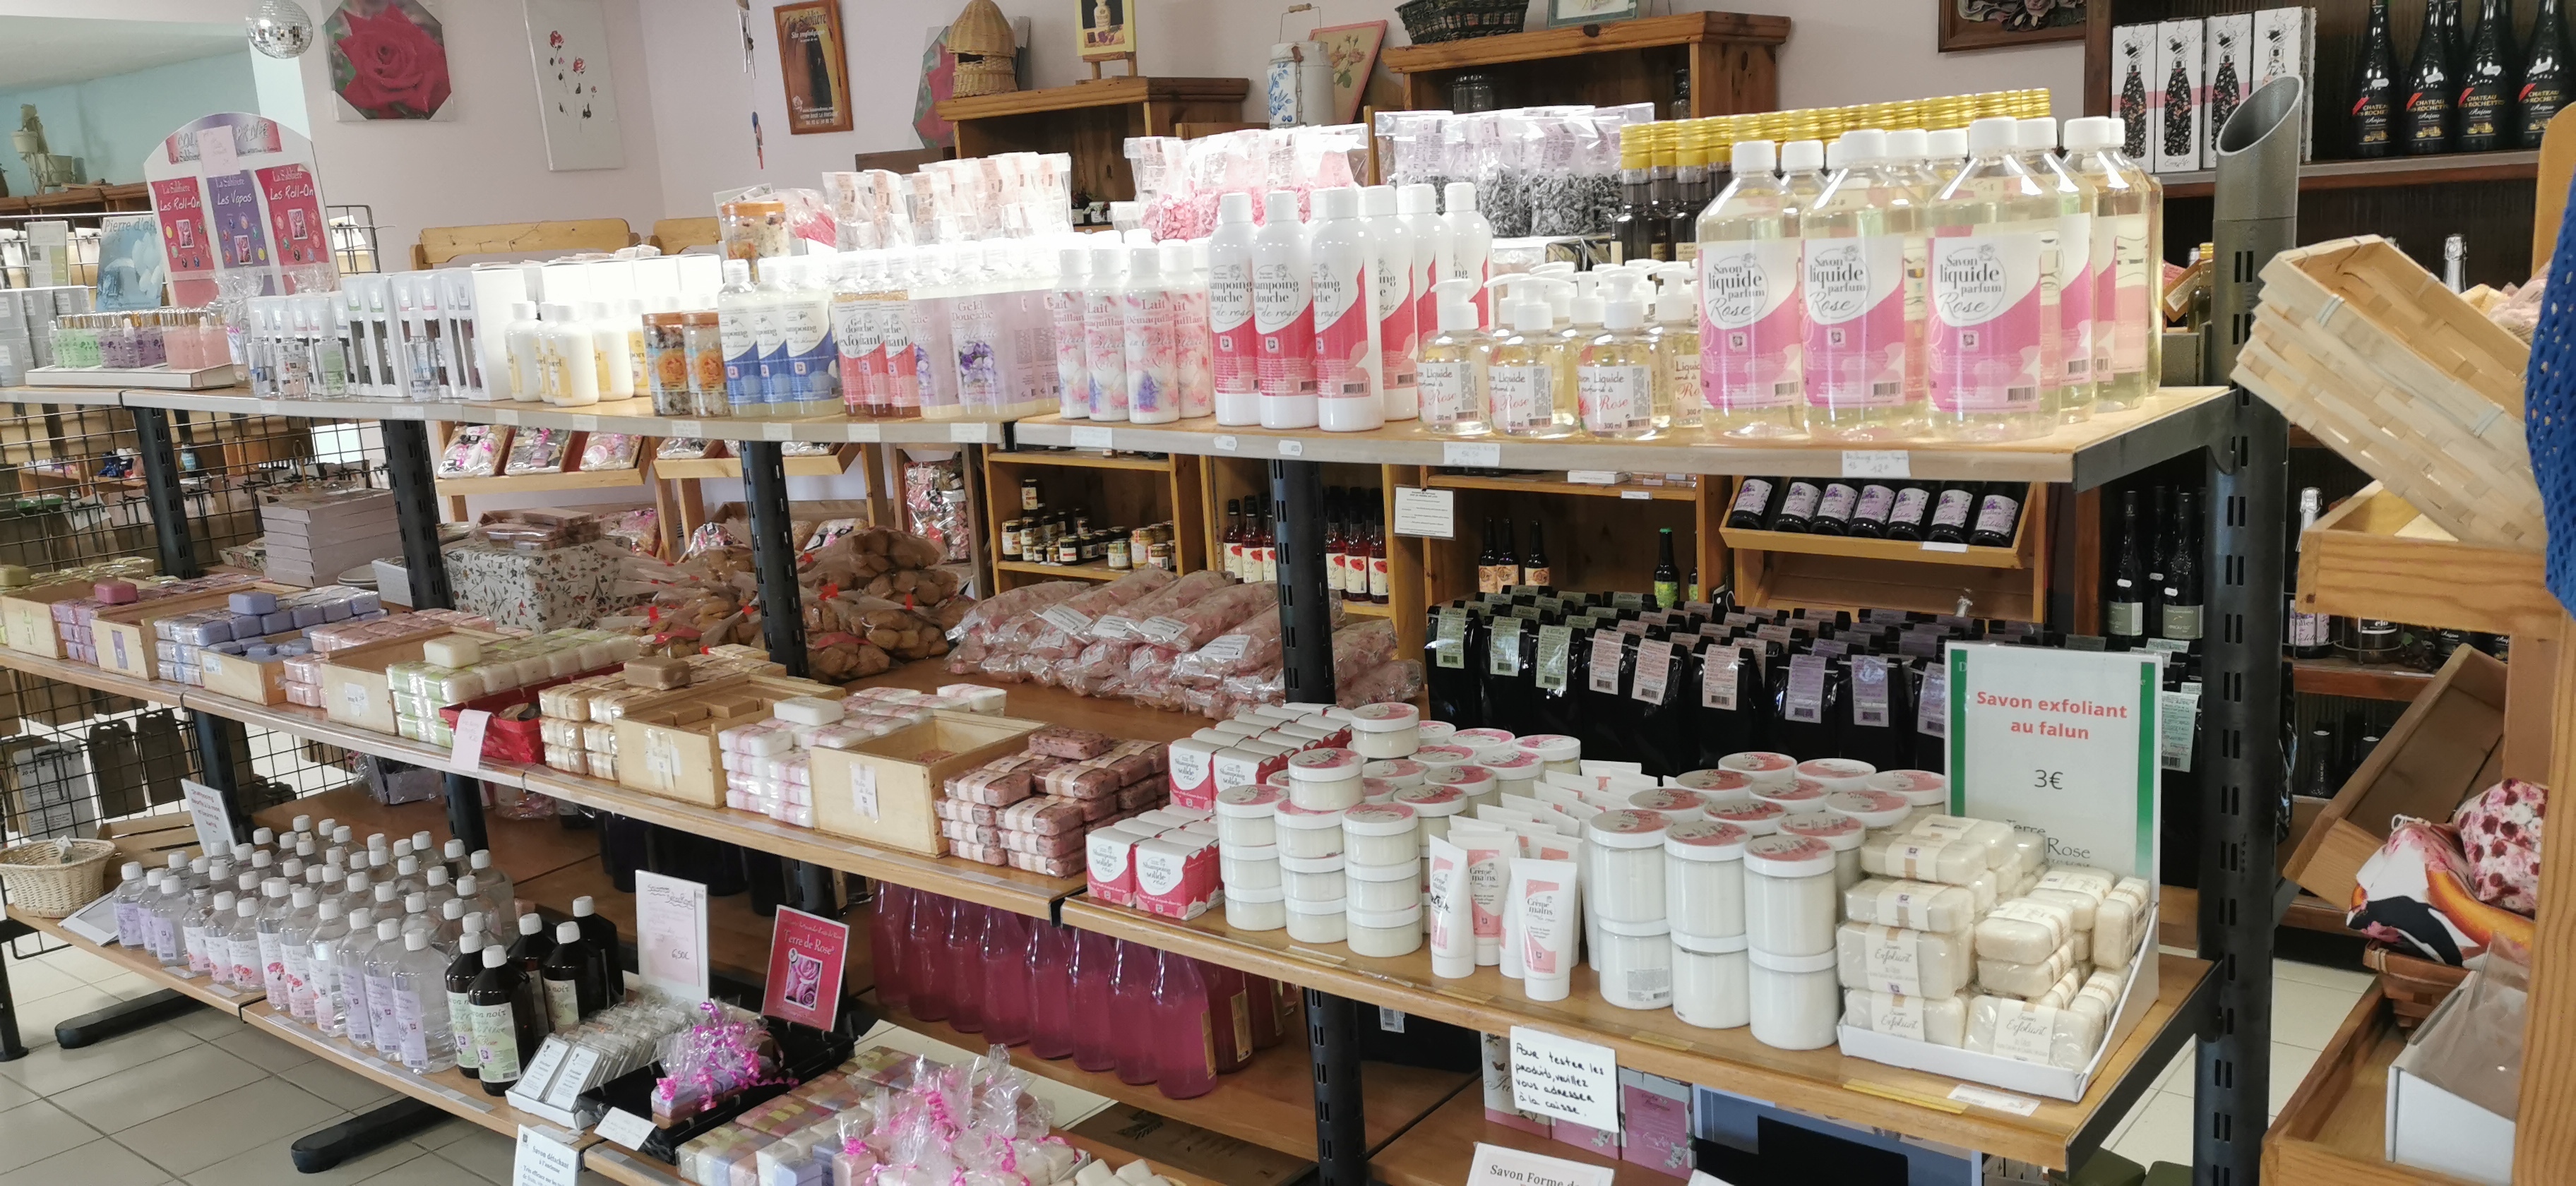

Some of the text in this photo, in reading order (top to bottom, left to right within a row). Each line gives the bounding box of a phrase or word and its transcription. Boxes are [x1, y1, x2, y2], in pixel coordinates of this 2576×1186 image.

[217, 189, 253, 208] Les Vapos
[270, 184, 314, 200] Les Roll-On
[160, 196, 201, 212] Les Roll-On
[104, 219, 131, 233] Pierre
[1814, 256, 1843, 268] Savon
[1946, 254, 1978, 268] Savon
[1713, 263, 1742, 275] Savon
[1809, 263, 1864, 289] liquide
[1940, 263, 2000, 289] liquide
[1708, 270, 1763, 296] liquide
[1827, 282, 1866, 296] parfum
[1960, 282, 2002, 296] parfum
[1210, 291, 1243, 303] douche
[1256, 291, 1289, 303] douche
[1728, 288, 1765, 302] parfum
[1055, 299, 1068, 309] ait
[1087, 302, 1109, 314] Lait
[1142, 299, 1166, 311] Lait
[1173, 301, 1186, 311] ait
[1708, 296, 1753, 323] Rose
[1809, 291, 1855, 318] Rose
[1939, 292, 1990, 316] Rose
[1426, 366, 1453, 381] Liquide
[1498, 372, 1526, 386] Liquide
[1593, 371, 1624, 386] Liquide
[1428, 388, 1457, 406] Rose
[1677, 382, 1700, 400] Ro
[1500, 394, 1530, 412] Rose
[1595, 395, 1628, 413] Rose
[1976, 691, 2128, 719] Savon exfoliant
[2010, 721, 2089, 740] au falun
[1174, 757, 1199, 771] Shampoing
[1177, 767, 1195, 776] solide
[1219, 767, 1246, 781] Shampoing
[1222, 777, 1241, 786] solide
[2034, 769, 2064, 790] 3€
[1092, 848, 1118, 862] Shampoing
[2047, 837, 2091, 859] Rose
[1143, 861, 1171, 875] Shampoing
[1469, 866, 1493, 875] Crème
[1472, 873, 1496, 882] mains
[1527, 898, 1551, 908] Crème
[1529, 906, 1553, 916] mains
[783, 928, 803, 946] Terre
[804, 933, 813, 949] de
[1874, 949, 1912, 964] Exfoliant
[486, 1009, 506, 1018] noir
[1881, 1014, 1919, 1030] Exfoliant
[2006, 1019, 2048, 1036] Exfoliant
[1515, 1042, 1605, 1076] Pour tester les
[1515, 1079, 1539, 1091] vous
[1544, 1085, 1595, 1103] adresser
[1519, 1091, 1526, 1102] à
[1527, 1094, 1541, 1106] la
[532, 1144, 546, 1158] Savon
[1490, 1164, 1566, 1186] Savon Forme
